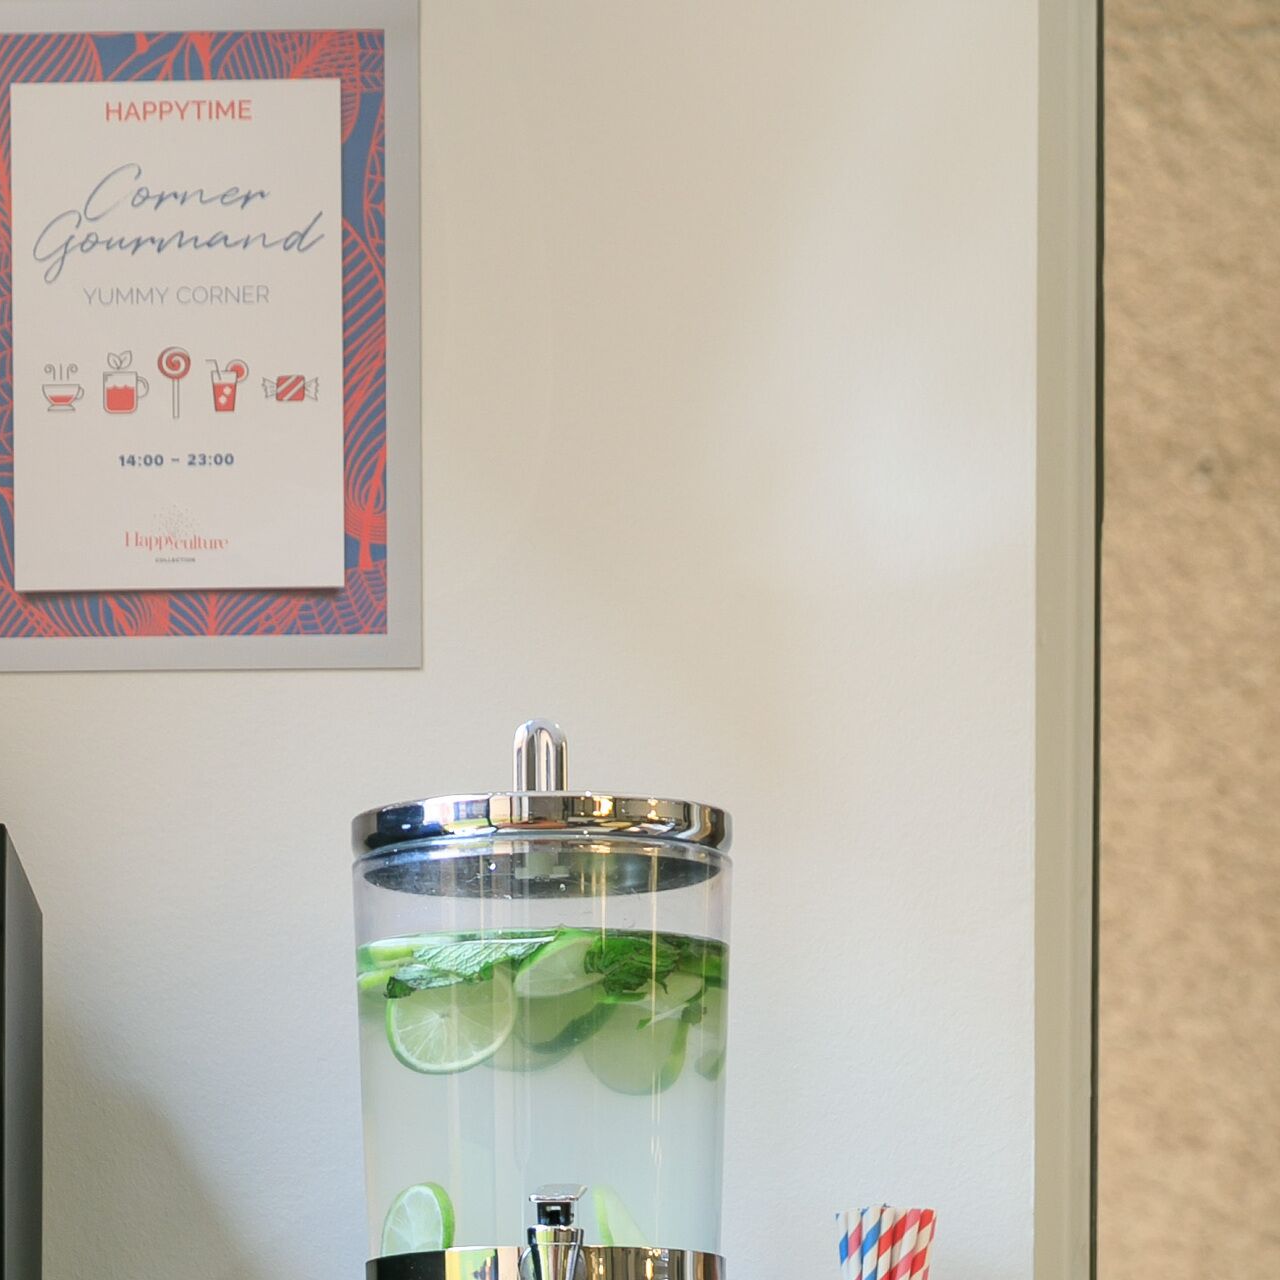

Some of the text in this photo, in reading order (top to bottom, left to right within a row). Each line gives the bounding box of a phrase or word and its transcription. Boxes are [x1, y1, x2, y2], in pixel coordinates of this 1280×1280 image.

[104, 99, 253, 122] HAPPYTIME
[83, 162, 270, 222] Corner
[32, 209, 325, 284] Gourmand
[82, 285, 270, 306] YUMMY CORNER
[119, 454, 164, 467] 14:00
[187, 453, 235, 466] 23:00
